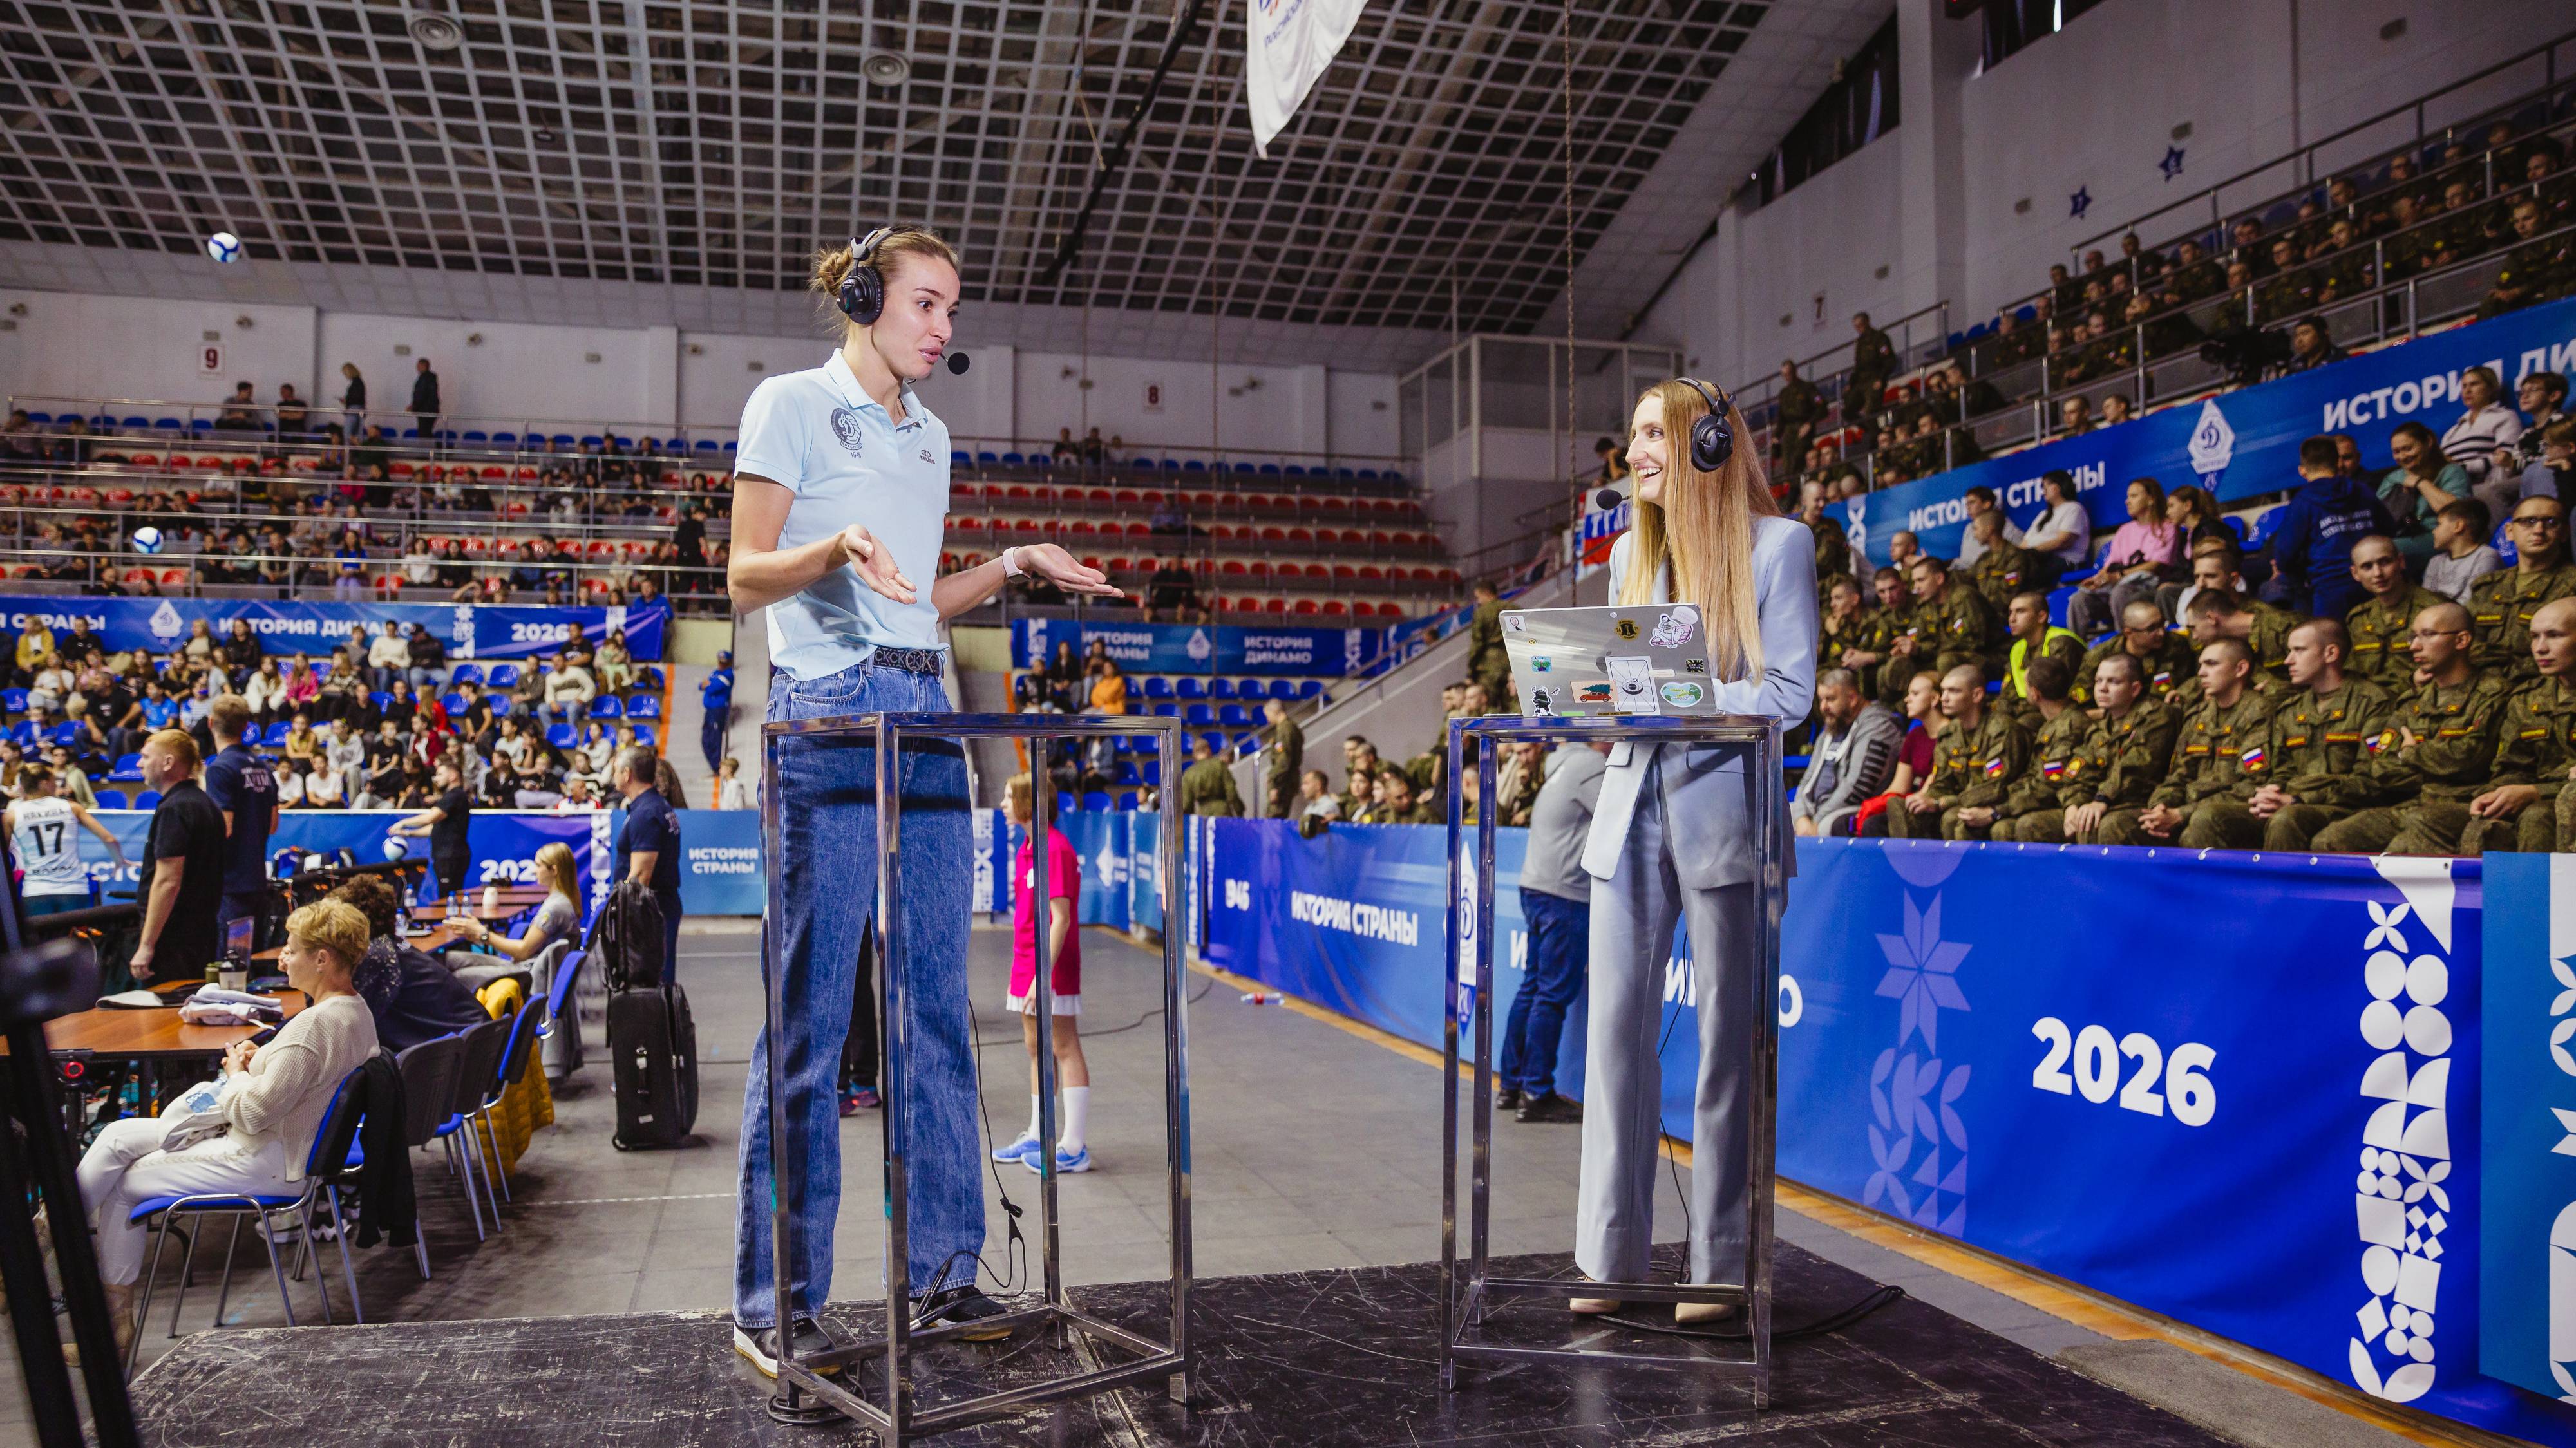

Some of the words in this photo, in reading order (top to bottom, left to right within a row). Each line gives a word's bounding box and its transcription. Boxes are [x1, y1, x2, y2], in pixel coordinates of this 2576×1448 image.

[205, 348, 218, 369] 9
[1148, 386, 1159, 404] 8
[218, 619, 317, 635] ИТОРИЯ
[511, 623, 569, 642] 2026
[1244, 636, 1313, 650] ИСТОРИЯ
[1084, 646, 1149, 660] СРАНЫ
[1244, 650, 1312, 664] ДИНАМО
[28, 822, 64, 856] 17
[688, 847, 759, 861] ИСТОРИЯ
[479, 858, 536, 882] 202
[692, 861, 755, 874] СТРАНЫ
[1352, 903, 1418, 947] СТРАНЫ
[2031, 1015, 2217, 1127] 2026
